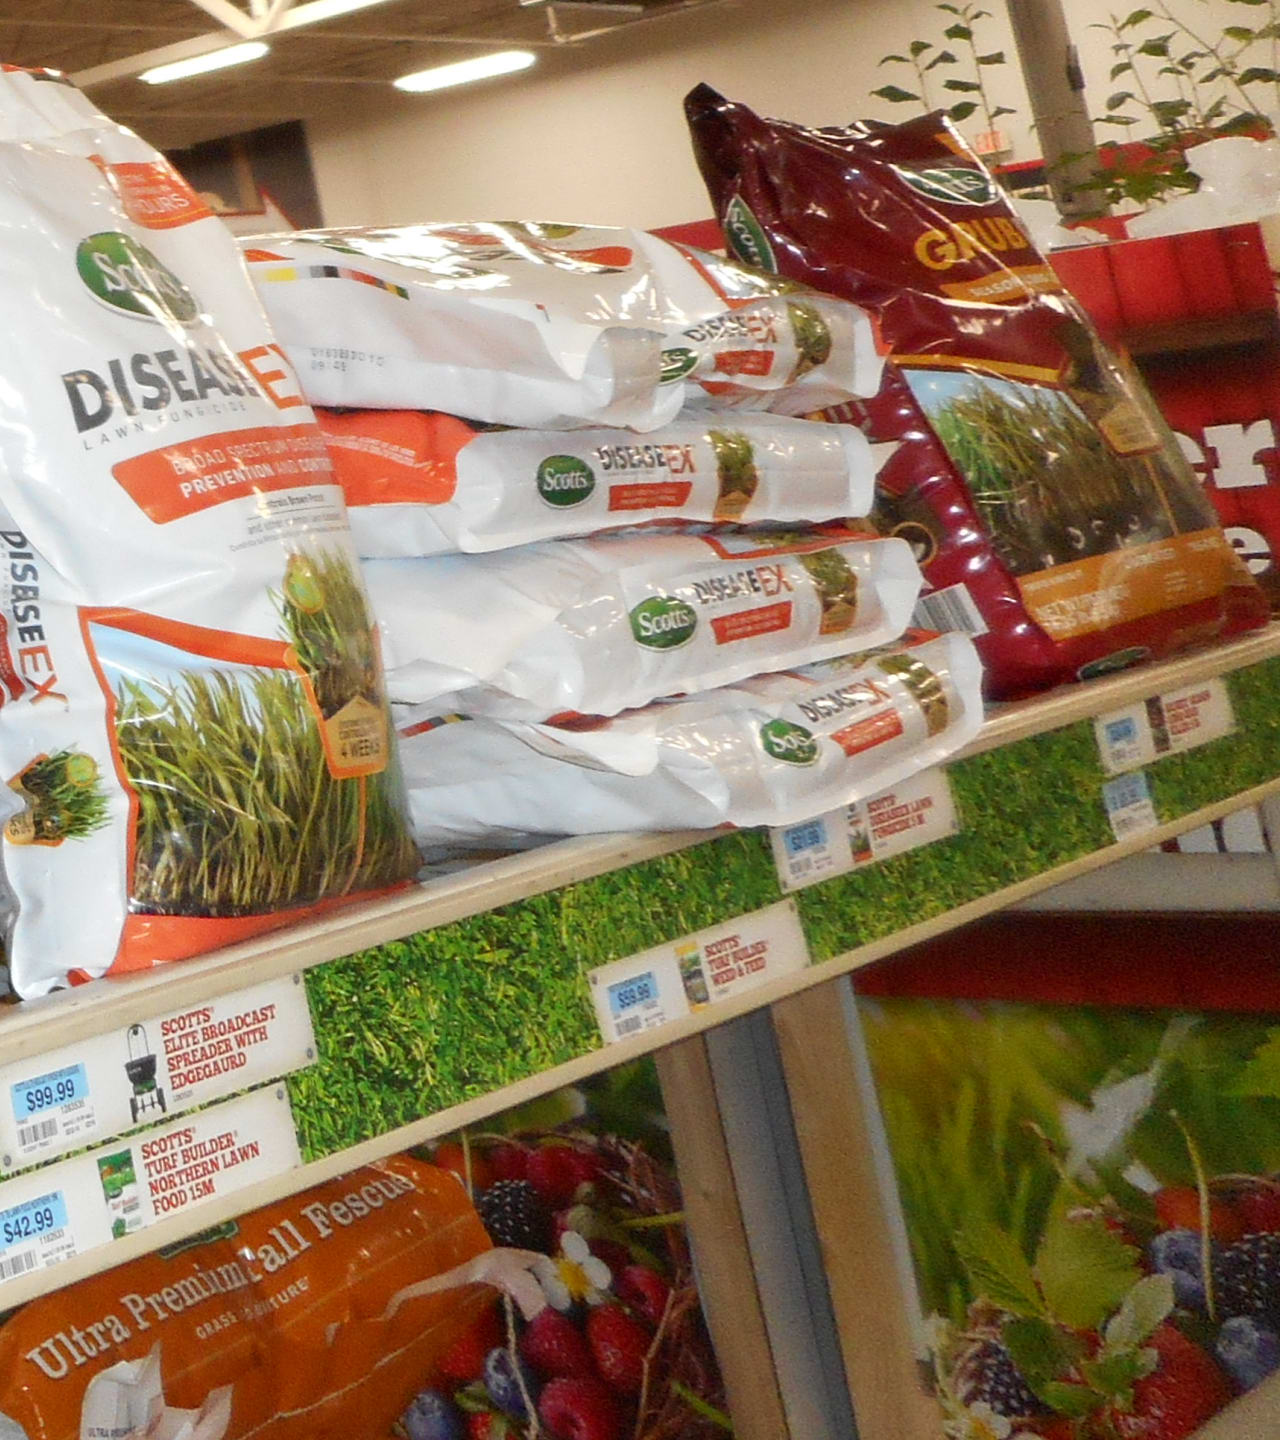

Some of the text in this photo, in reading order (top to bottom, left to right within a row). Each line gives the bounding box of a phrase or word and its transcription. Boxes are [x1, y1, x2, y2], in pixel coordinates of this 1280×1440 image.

[83, 421, 144, 451] LAWN
[171, 449, 227, 476] BROAD
[179, 463, 275, 498] PREVENTION
[543, 467, 588, 492] Scotts
[638, 609, 691, 636] Scotts
[161, 1008, 211, 1036] SCOTTS
[163, 1003, 276, 1055] ELITE BROADCAST
[167, 1024, 269, 1073] SPREADER WITH
[170, 1051, 247, 1091] EDGEGAURD
[26, 1078, 76, 1112] $99.99
[141, 1128, 192, 1160] SCOTTS
[144, 1133, 235, 1180] TURF BUILDER
[148, 1140, 261, 1197] NORTHERN LAWN
[152, 1178, 216, 1216] FOOD 15M
[3, 1207, 55, 1244] $42.99
[25, 1316, 130, 1380] Ultra
[120, 1258, 248, 1332] Premium
[300, 1169, 418, 1241] Fescue
